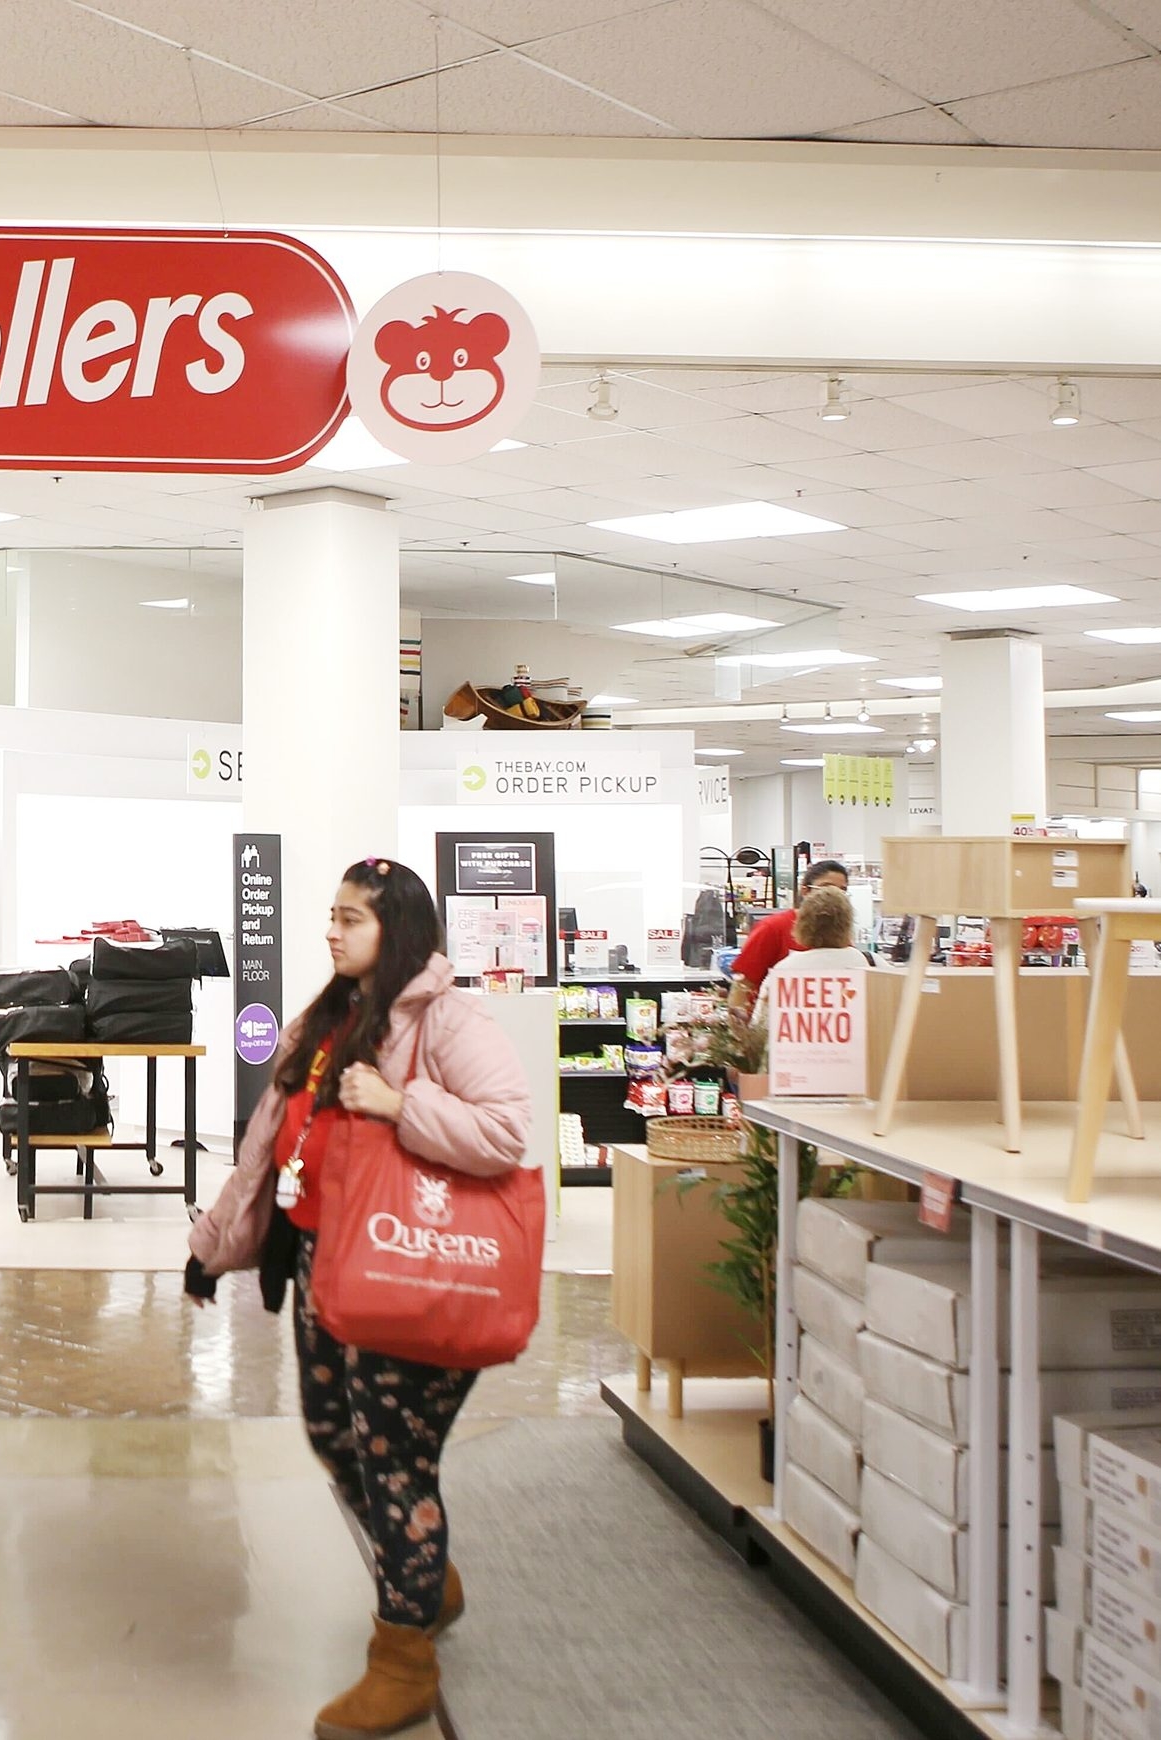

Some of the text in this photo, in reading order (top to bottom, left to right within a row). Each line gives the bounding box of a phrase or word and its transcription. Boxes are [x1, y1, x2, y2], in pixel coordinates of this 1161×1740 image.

[495, 761, 587, 773] THEBAY.COM
[495, 776, 657, 794] ORDER PICKUP
[484, 860, 531, 868] PURCHASE
[242, 873, 273, 886] Online
[242, 887, 270, 900] Order
[242, 903, 274, 917] Pickup
[242, 918, 260, 931] and
[242, 932, 274, 945] Return
[579, 931, 605, 939] SALE
[648, 930, 680, 939] SALE
[242, 960, 262, 970] MAIN
[242, 970, 269, 981] FLOOR
[777, 977, 851, 1008] MEET
[777, 1012, 851, 1043] ANKO
[367, 1212, 500, 1261] Queens
